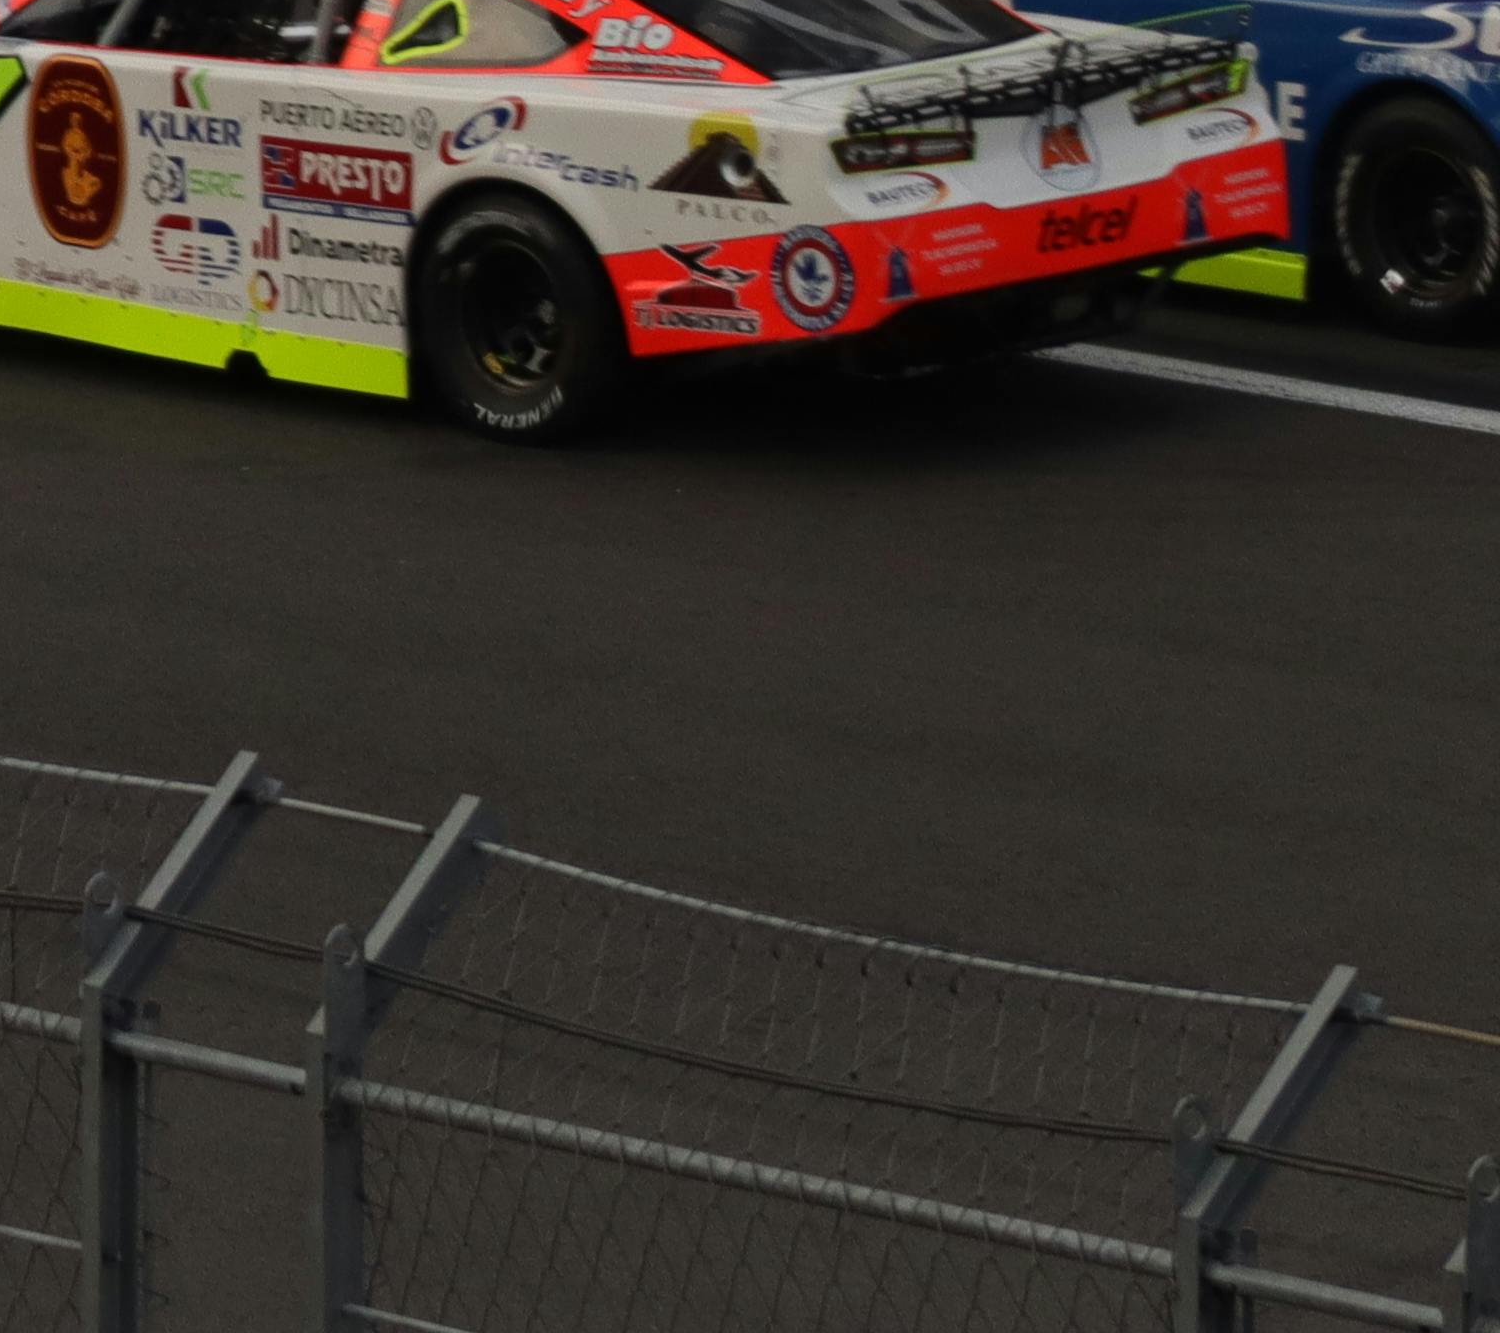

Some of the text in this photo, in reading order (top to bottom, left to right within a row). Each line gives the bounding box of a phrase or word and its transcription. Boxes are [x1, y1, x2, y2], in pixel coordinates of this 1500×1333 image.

[592, 14, 674, 51] Bio
[260, 99, 336, 133] PUERTO
[303, 153, 404, 202] PRESTO
[1037, 195, 1138, 256] telcel
